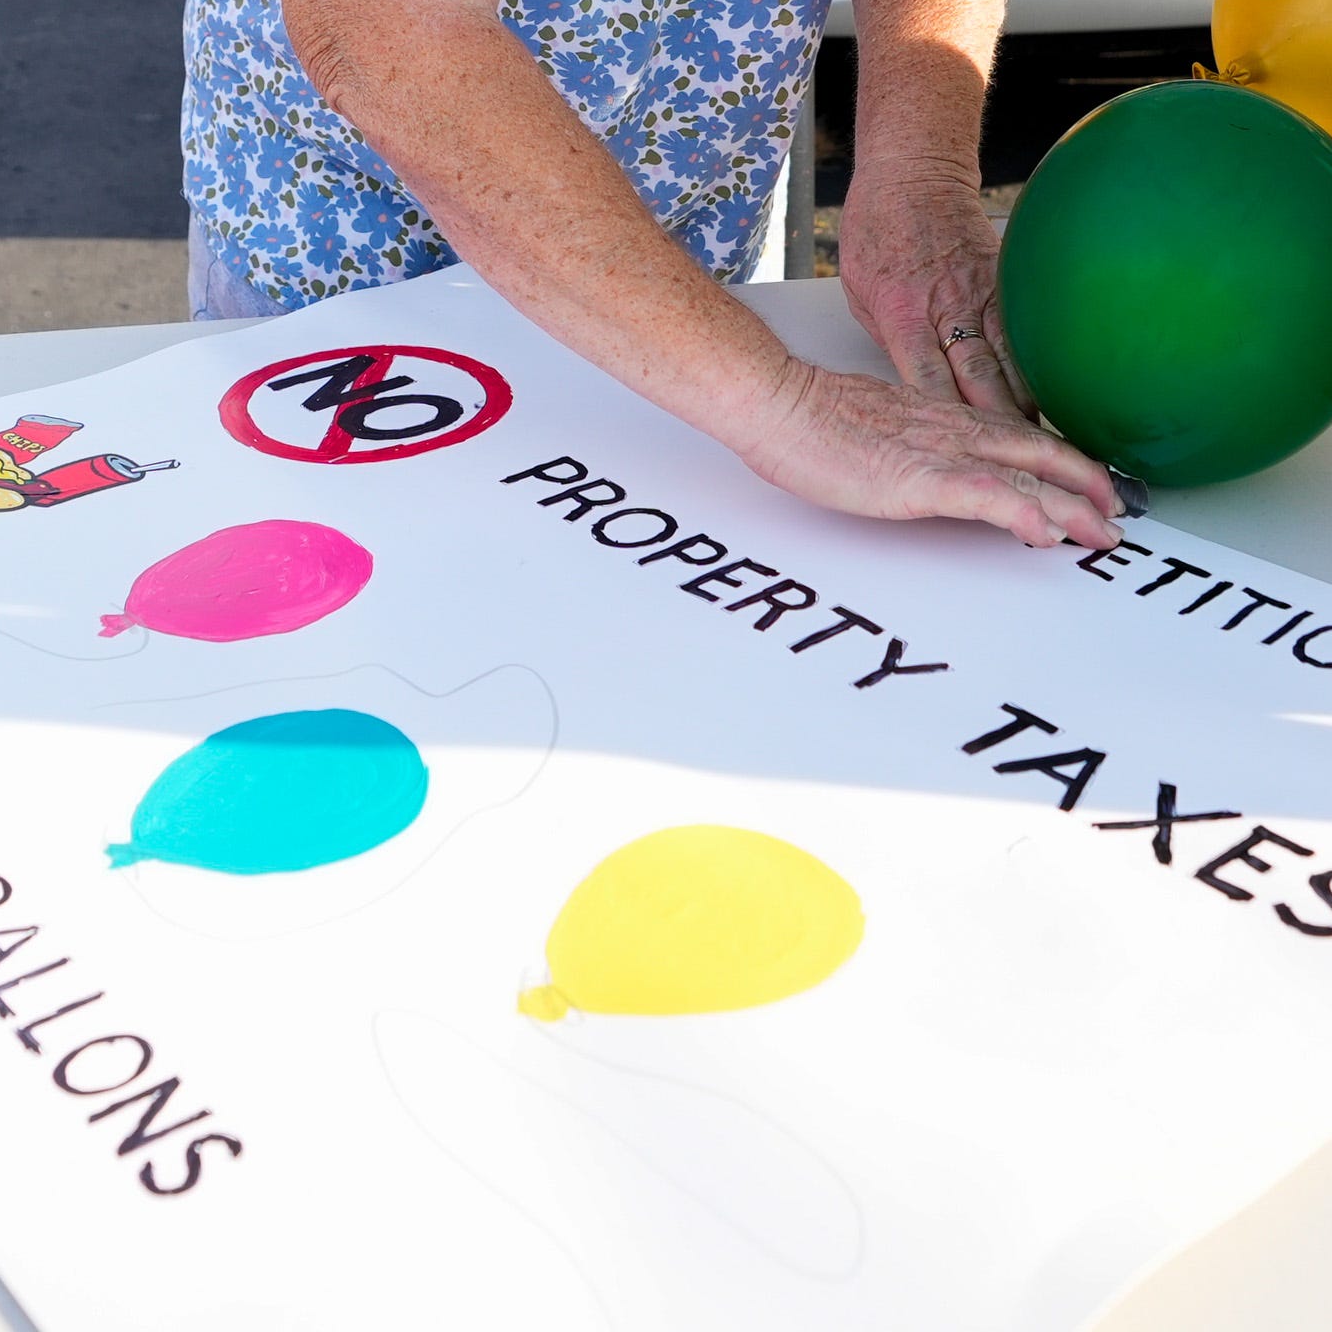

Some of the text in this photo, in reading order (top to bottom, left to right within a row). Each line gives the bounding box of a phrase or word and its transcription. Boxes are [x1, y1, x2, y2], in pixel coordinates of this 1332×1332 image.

[2, 431, 48, 454] CHIPS
[266, 354, 465, 441] NO
[500, 455, 951, 690] PROPERTY
